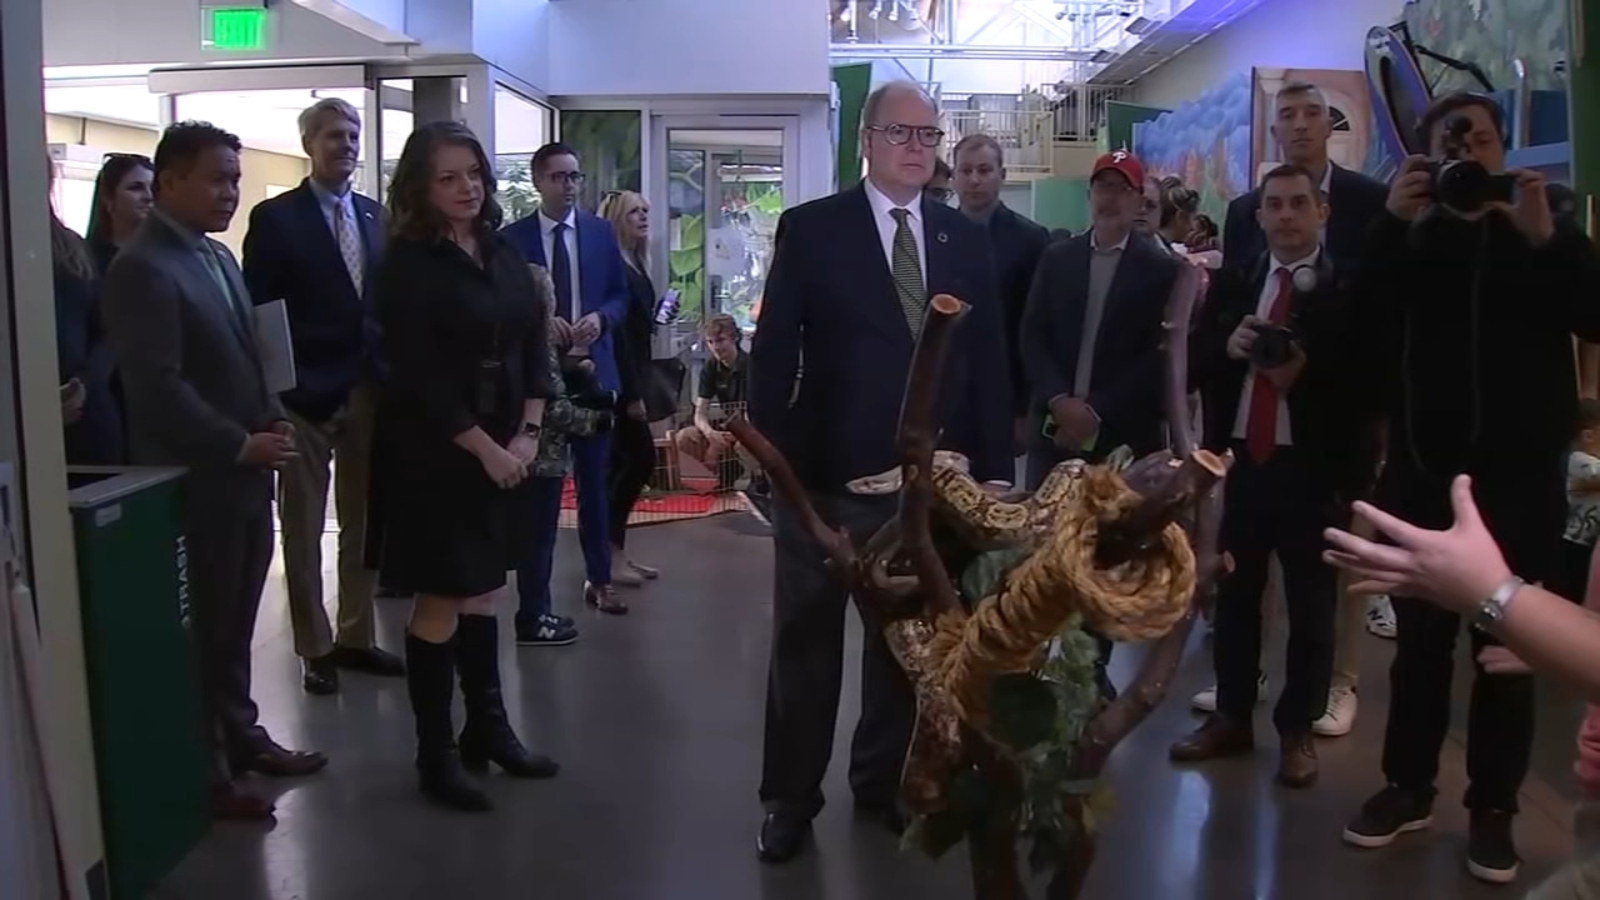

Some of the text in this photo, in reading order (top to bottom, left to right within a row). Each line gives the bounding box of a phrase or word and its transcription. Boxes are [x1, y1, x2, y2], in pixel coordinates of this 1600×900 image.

[1112, 151, 1127, 164] P
[176, 535, 190, 615] TRASH
[537, 626, 556, 639] N
